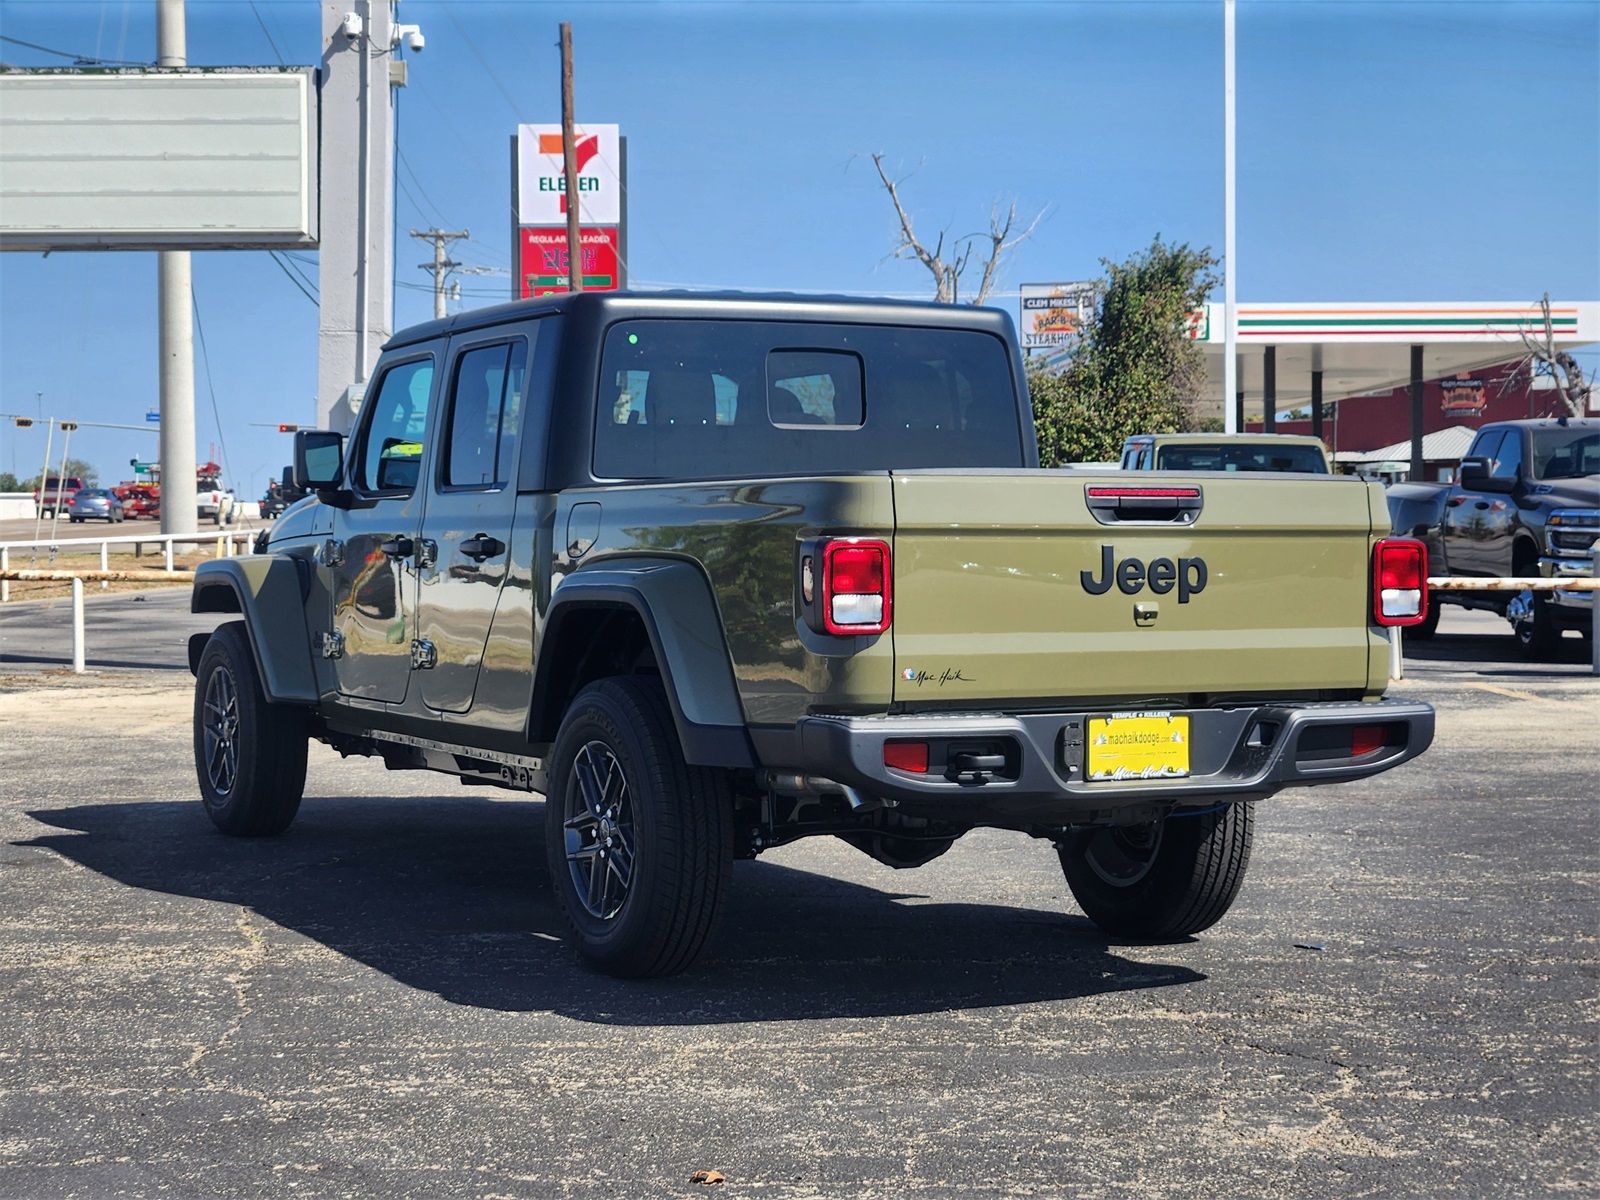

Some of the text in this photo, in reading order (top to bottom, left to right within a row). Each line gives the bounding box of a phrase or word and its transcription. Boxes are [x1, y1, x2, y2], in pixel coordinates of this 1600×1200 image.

[539, 177, 599, 191] ELEEn
[529, 235, 610, 243] REGULAR LEADED
[1026, 299, 1048, 308] CLEM
[1080, 544, 1208, 604] Jeep
[915, 668, 971, 687] Mac Haik
[1113, 765, 1140, 780] Mac
